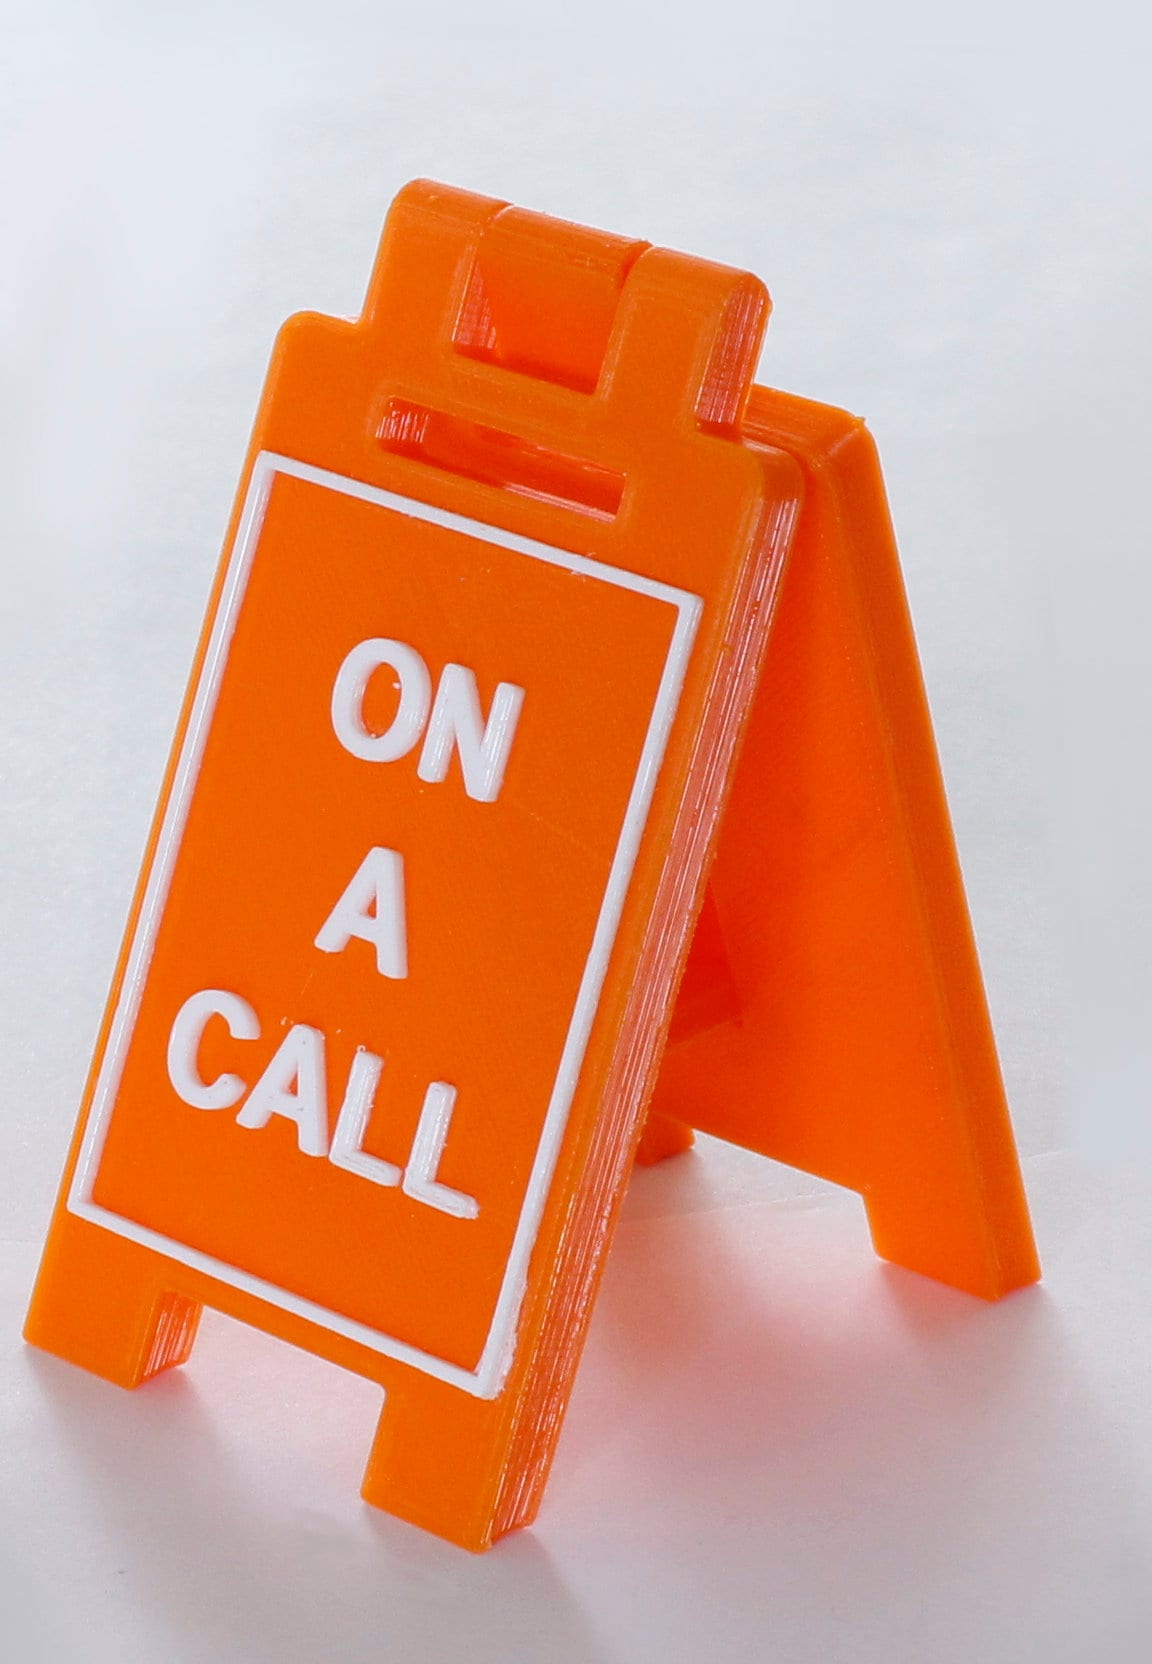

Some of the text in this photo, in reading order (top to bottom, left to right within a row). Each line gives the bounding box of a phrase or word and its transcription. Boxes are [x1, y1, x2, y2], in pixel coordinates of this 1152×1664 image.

[331, 638, 525, 803] ON
[314, 846, 407, 979] A
[167, 989, 480, 1219] CALL
